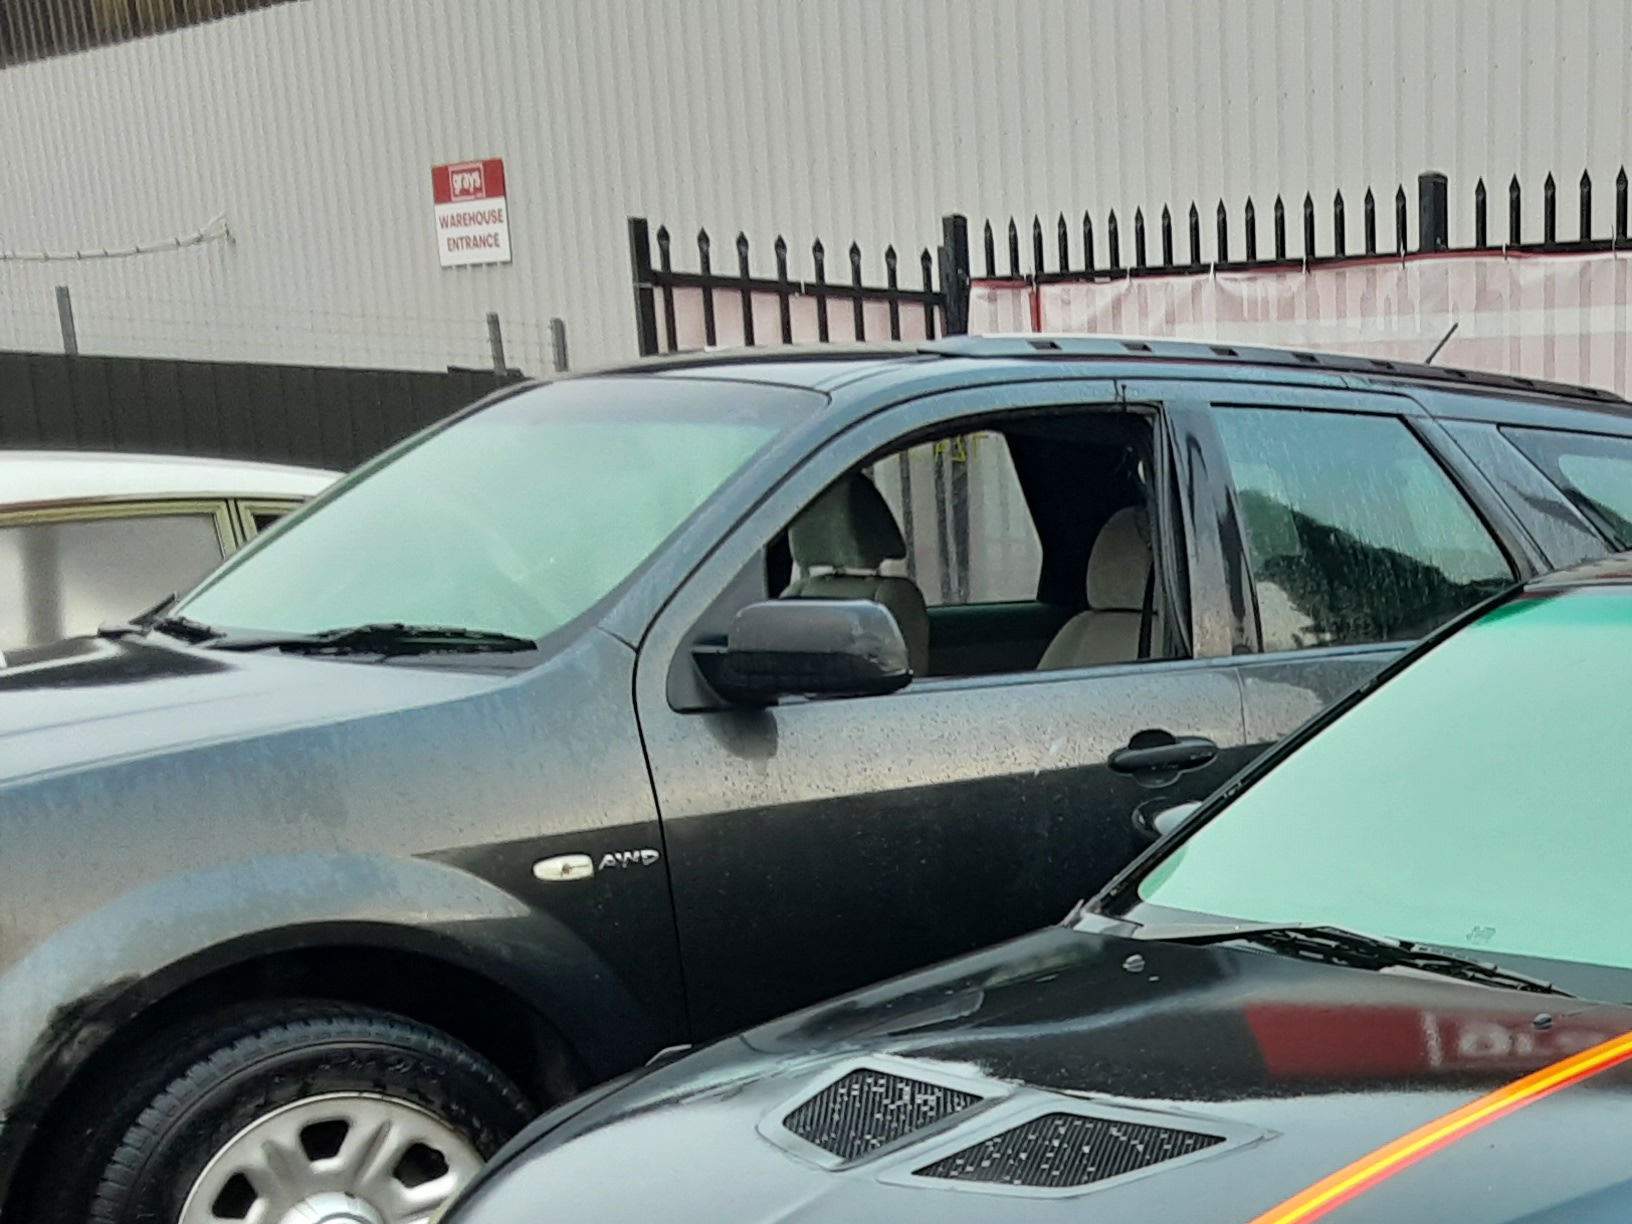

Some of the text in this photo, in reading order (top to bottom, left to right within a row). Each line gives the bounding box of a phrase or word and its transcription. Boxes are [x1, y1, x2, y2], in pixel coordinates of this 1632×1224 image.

[439, 208, 504, 229] WAREHOUSE
[447, 233, 500, 252] ENTRANCE
[599, 849, 660, 871] AWD
